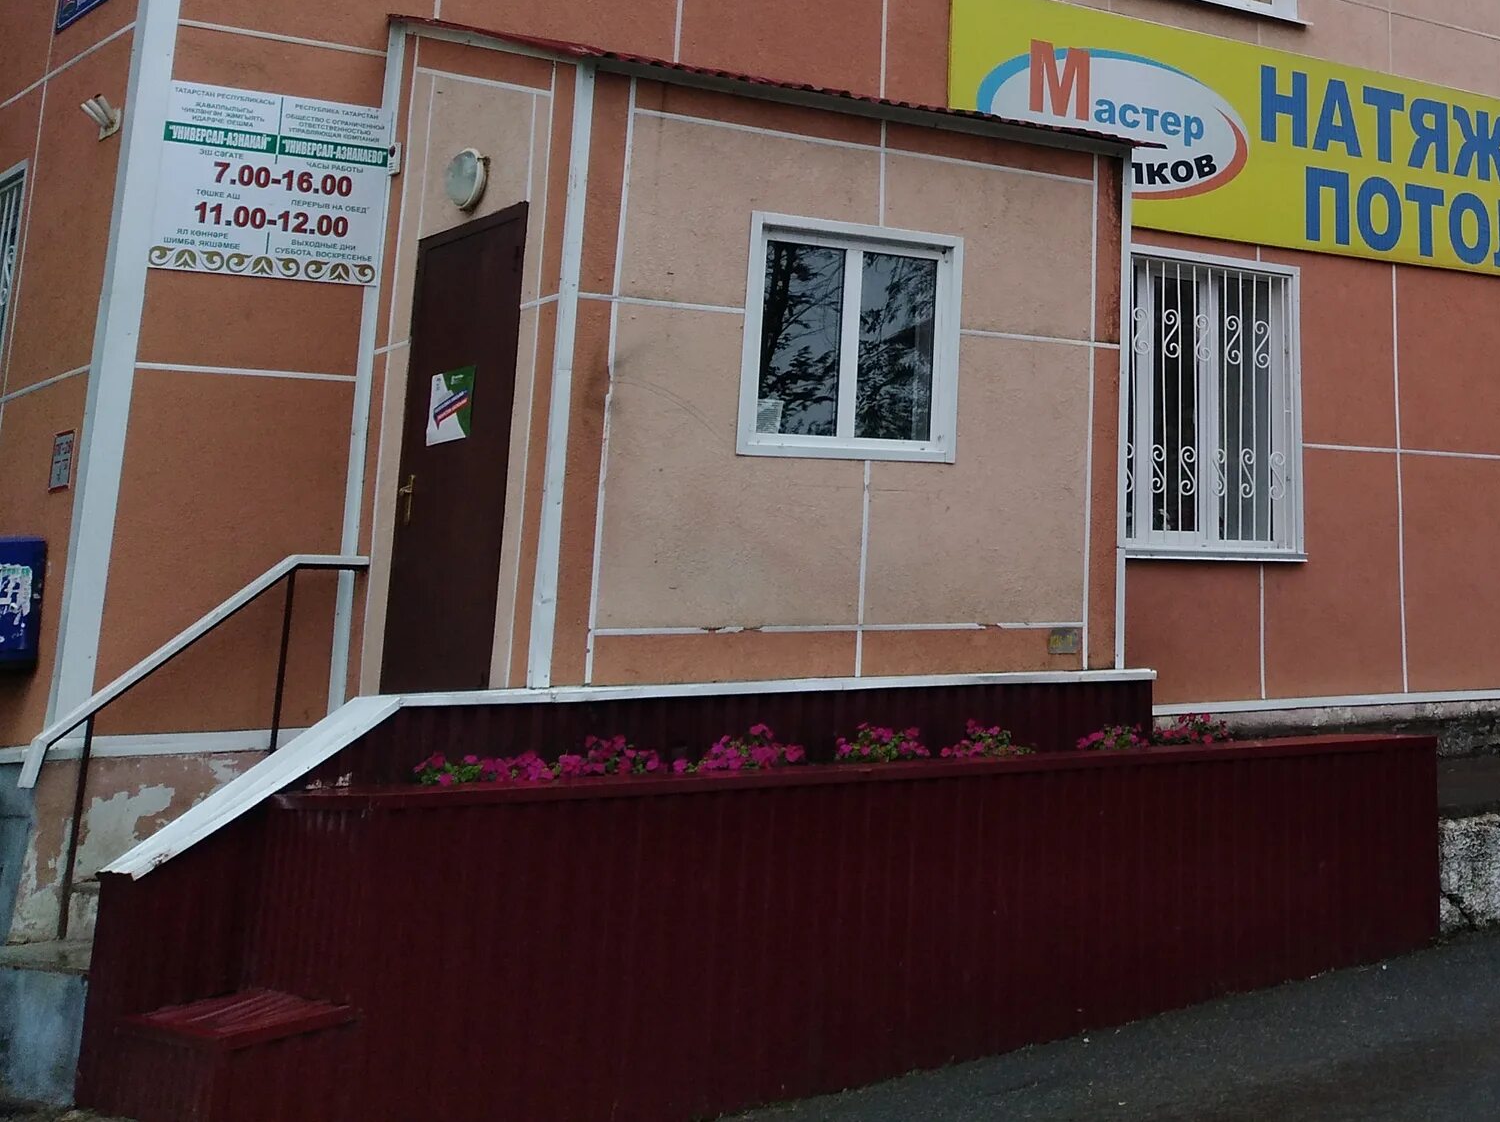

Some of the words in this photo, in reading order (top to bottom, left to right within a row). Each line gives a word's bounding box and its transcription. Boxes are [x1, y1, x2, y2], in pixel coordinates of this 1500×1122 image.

[175, 86, 215, 98] ТАТАРСТАН
[1029, 39, 1205, 147] Мастер
[294, 103, 340, 115] РЕСПУБЛИКА
[342, 109, 379, 120] ТАТАРСТАН
[286, 113, 325, 123] ОБЩЕСТВО
[199, 148, 213, 156] ЭШ
[306, 161, 330, 170] ЧАСЫ
[331, 164, 364, 174] РАБОТЫ
[1131, 153, 1218, 186] лков
[214, 161, 353, 197] 7.00-16.00
[226, 192, 241, 200] АШ
[291, 199, 331, 210] ПЕРЕРЫВ
[194, 201, 349, 238] 11.00-12.00
[176, 228, 189, 236] ЯЛ
[291, 239, 338, 250] ВЫХОДНЫЕ
[339, 244, 356, 252] ДНИ
[315, 251, 373, 262] ВОСКРЕСЕНЬЕ
